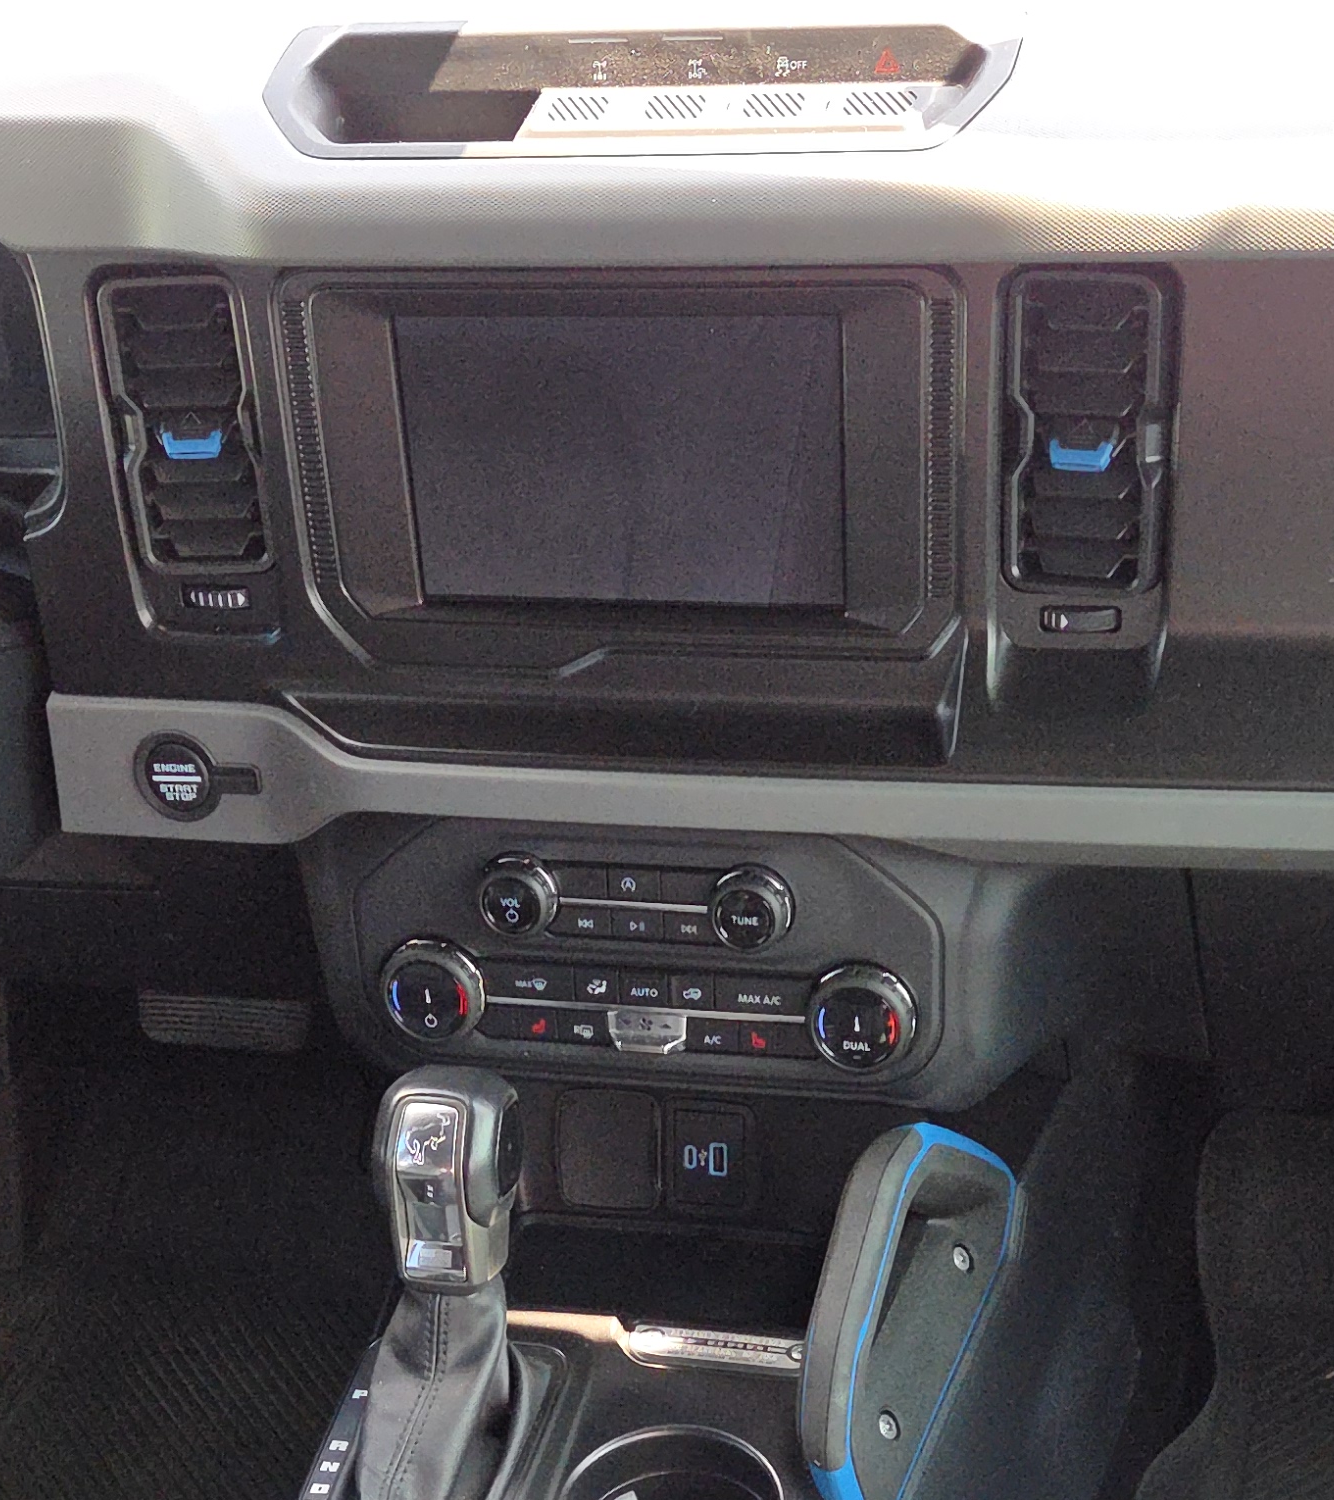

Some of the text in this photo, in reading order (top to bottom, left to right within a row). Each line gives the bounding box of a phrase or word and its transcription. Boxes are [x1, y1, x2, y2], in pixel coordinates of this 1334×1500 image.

[789, 60, 808, 70] OFF
[153, 763, 196, 773] ENGINE
[159, 783, 199, 793] START
[165, 791, 197, 801] STOP
[500, 897, 521, 909] VOL
[730, 914, 760, 927] TUNE
[630, 986, 659, 998] AUTO
[737, 992, 782, 1007] MAX A/C
[703, 1033, 722, 1046] A/C
[842, 1039, 871, 1052] DUAL
[351, 1388, 369, 1399] P
[319, 1460, 341, 1473] N
[309, 1482, 331, 1495] D
